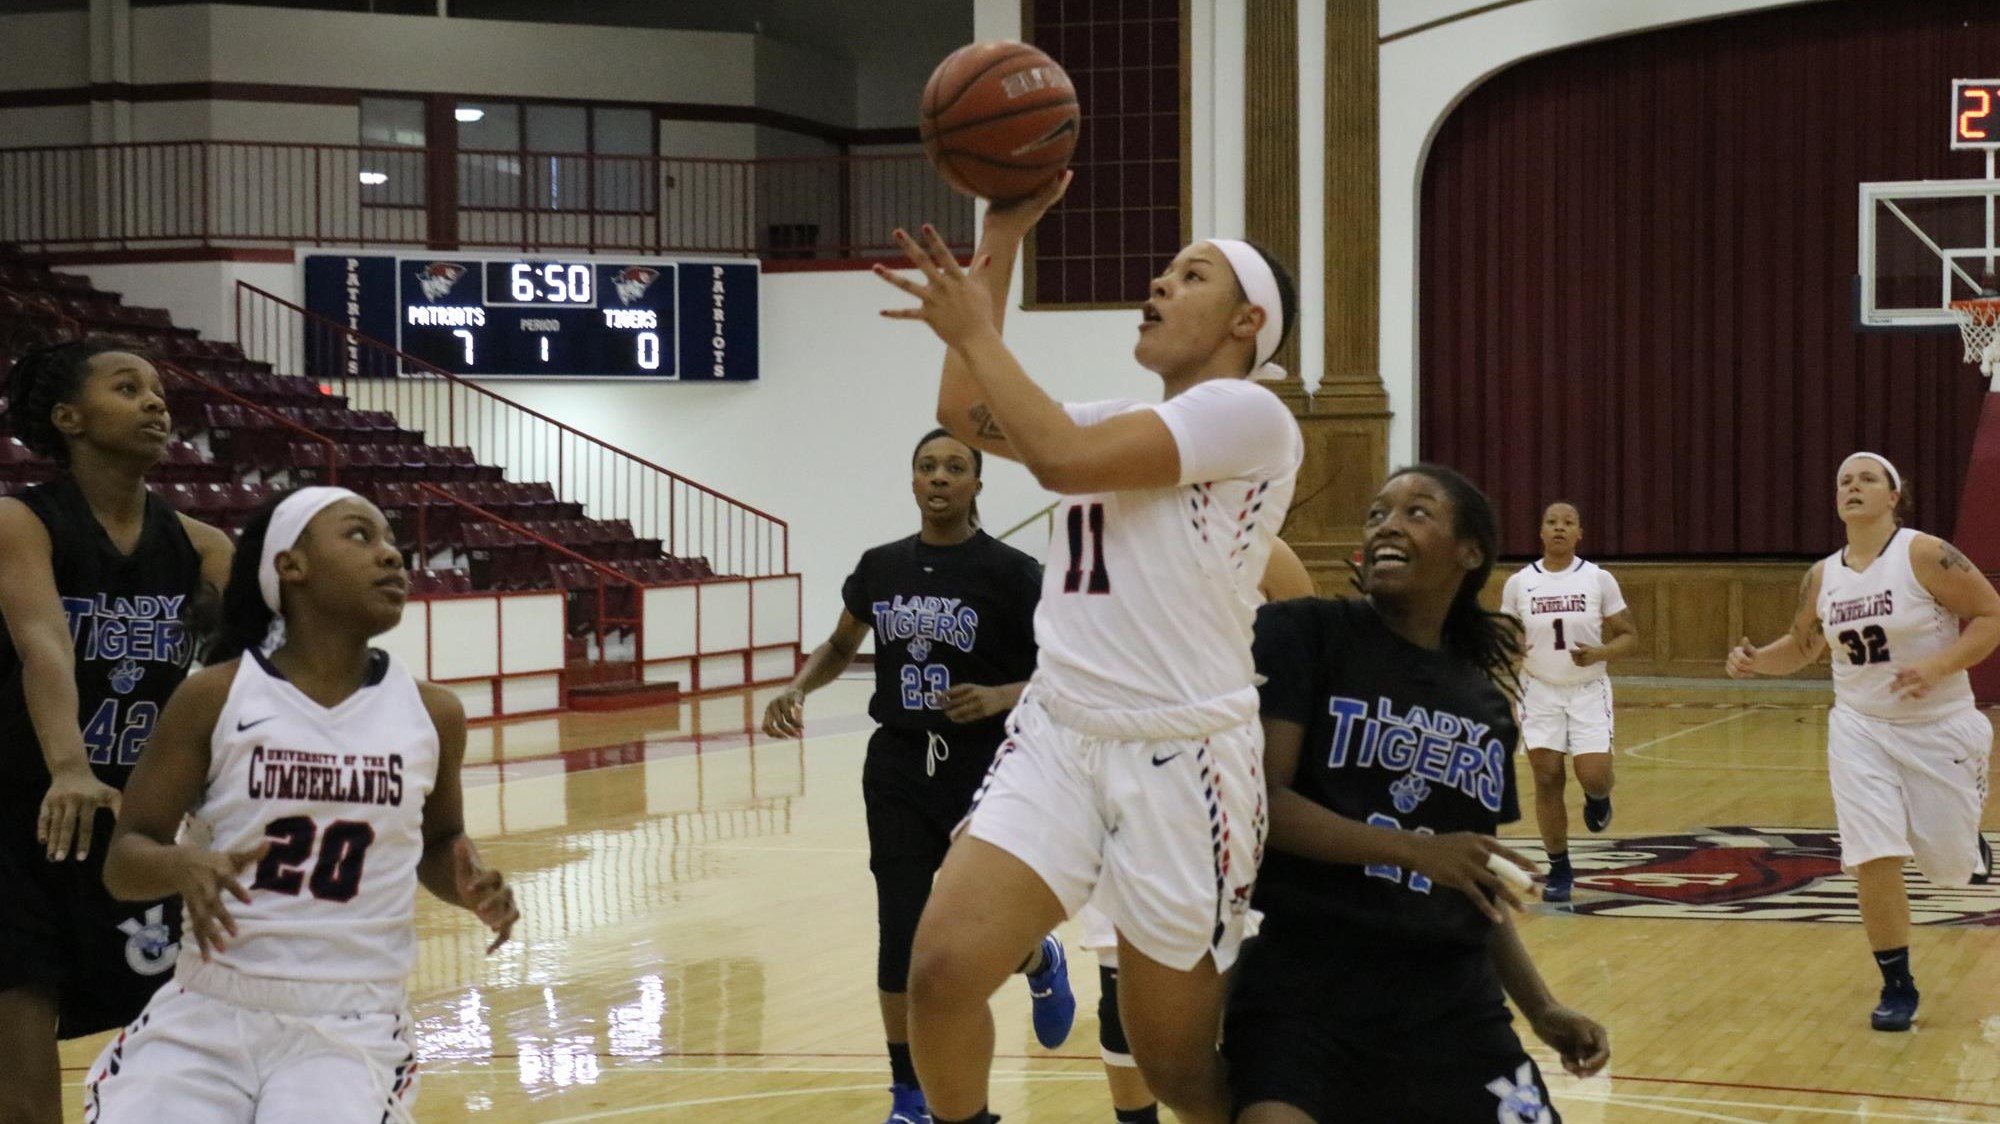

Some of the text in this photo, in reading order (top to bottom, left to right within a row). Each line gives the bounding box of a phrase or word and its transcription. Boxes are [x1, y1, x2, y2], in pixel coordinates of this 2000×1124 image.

[1959, 89, 2000, 139] 2
[511, 263, 591, 303] 6:50
[408, 306, 486, 327] PATRIOTS
[520, 318, 561, 332] PERIOD
[602, 309, 658, 329] TIGERS
[712, 266, 726, 378] PATRIOTS
[453, 329, 474, 366] 7
[540, 335, 549, 362] 1
[637, 332, 660, 370] 0
[1063, 503, 1111, 595] 11
[94, 592, 186, 620] LADY
[892, 594, 961, 615] LADY
[62, 596, 194, 669] TIGER
[872, 601, 979, 653] TIGERS
[1552, 618, 1567, 650] 1
[1838, 624, 1891, 667] 32
[900, 664, 951, 710] 23
[83, 698, 158, 765] 42
[1377, 696, 1490, 746] LADY
[267, 749, 385, 767] UNIVERSITY OF THE
[1328, 696, 1505, 812] TIGERS
[249, 745, 404, 807] CUMBERLANDS
[249, 816, 376, 904] 20
